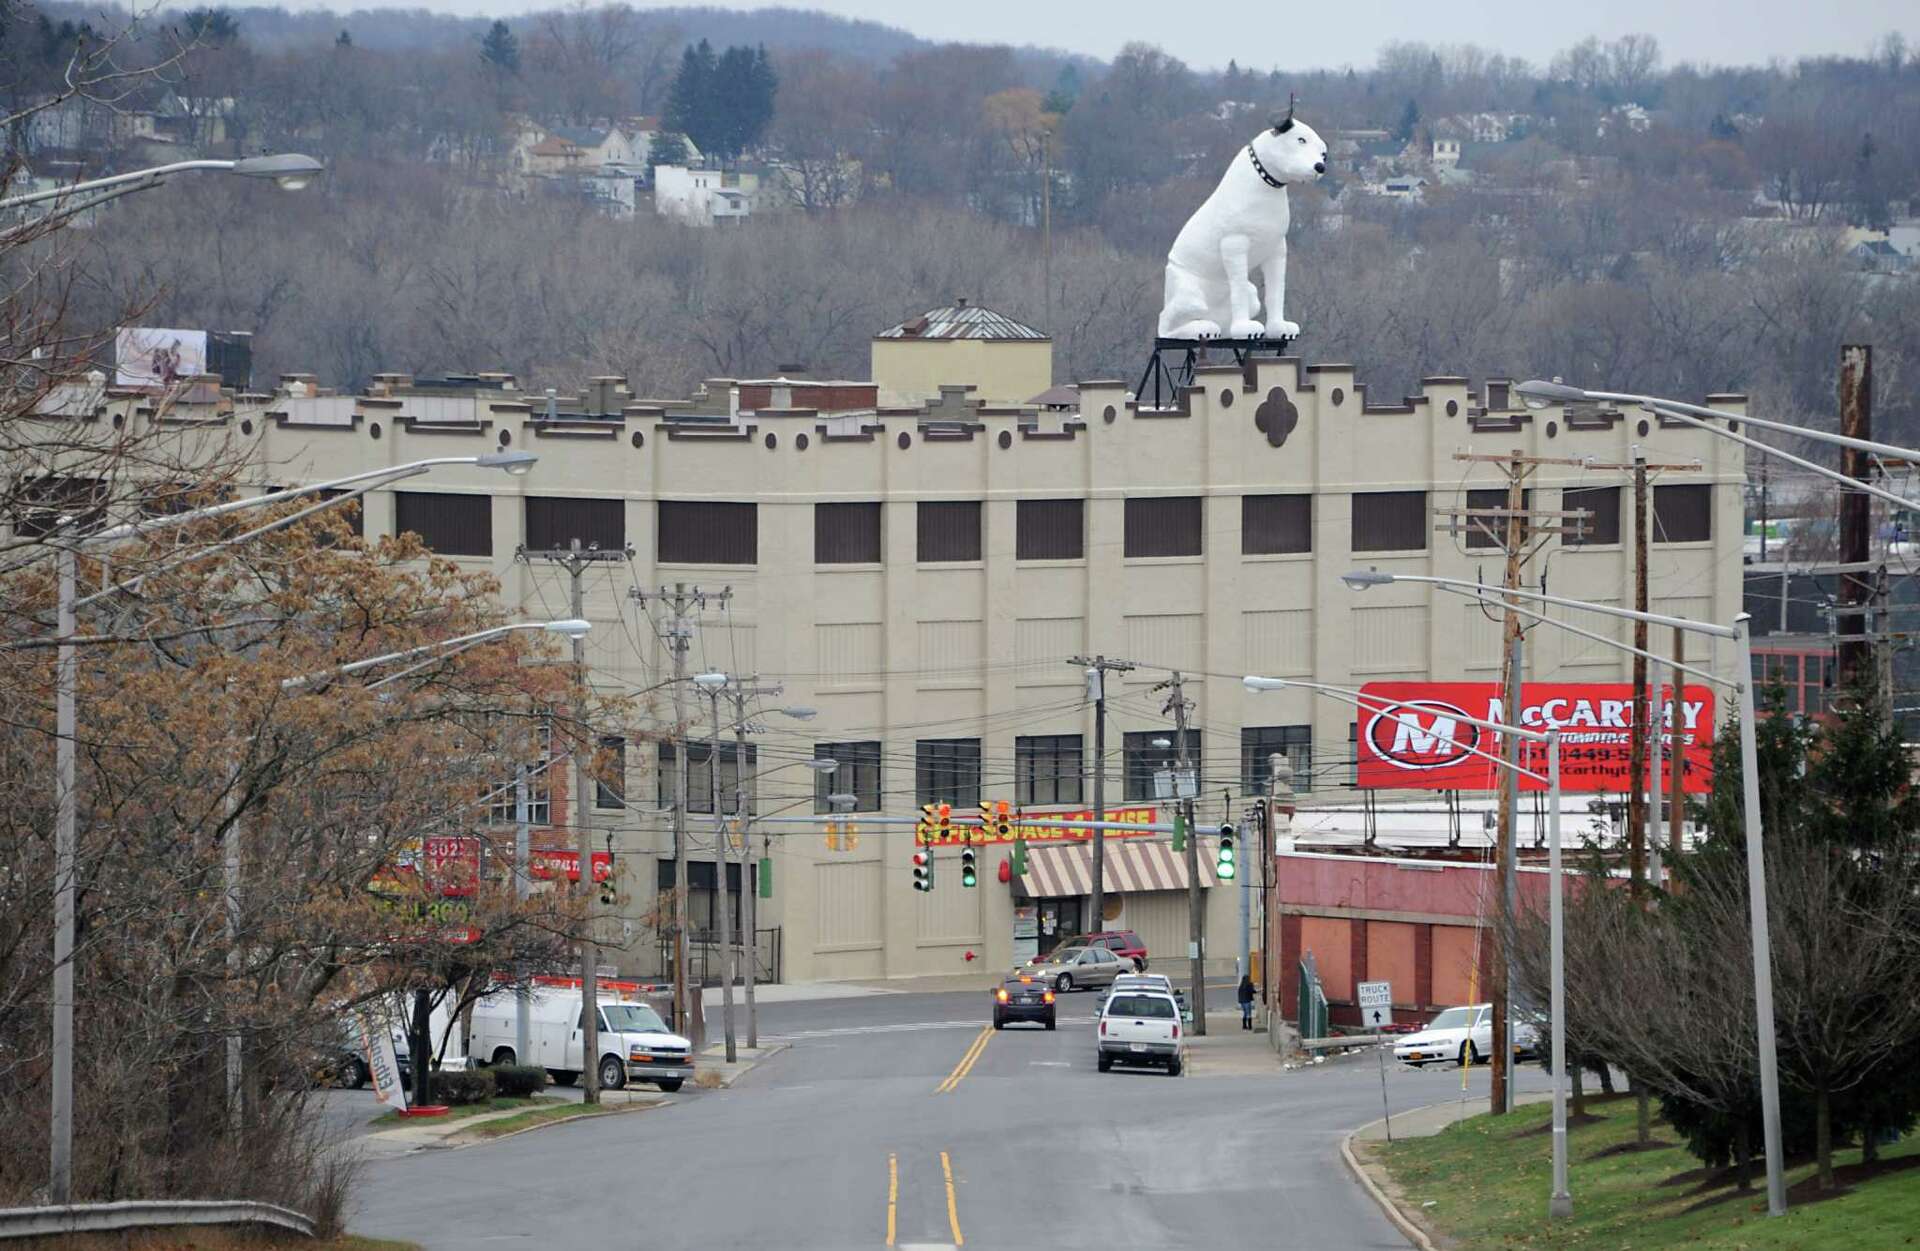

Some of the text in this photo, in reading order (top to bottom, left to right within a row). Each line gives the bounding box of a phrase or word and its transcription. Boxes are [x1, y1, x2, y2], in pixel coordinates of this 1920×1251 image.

[1547, 731, 1630, 744] TOMOTIVE
[1098, 810, 1150, 837] EASE
[1360, 985, 1388, 994] TRUCK
[1361, 994, 1390, 1004] ROUTE
